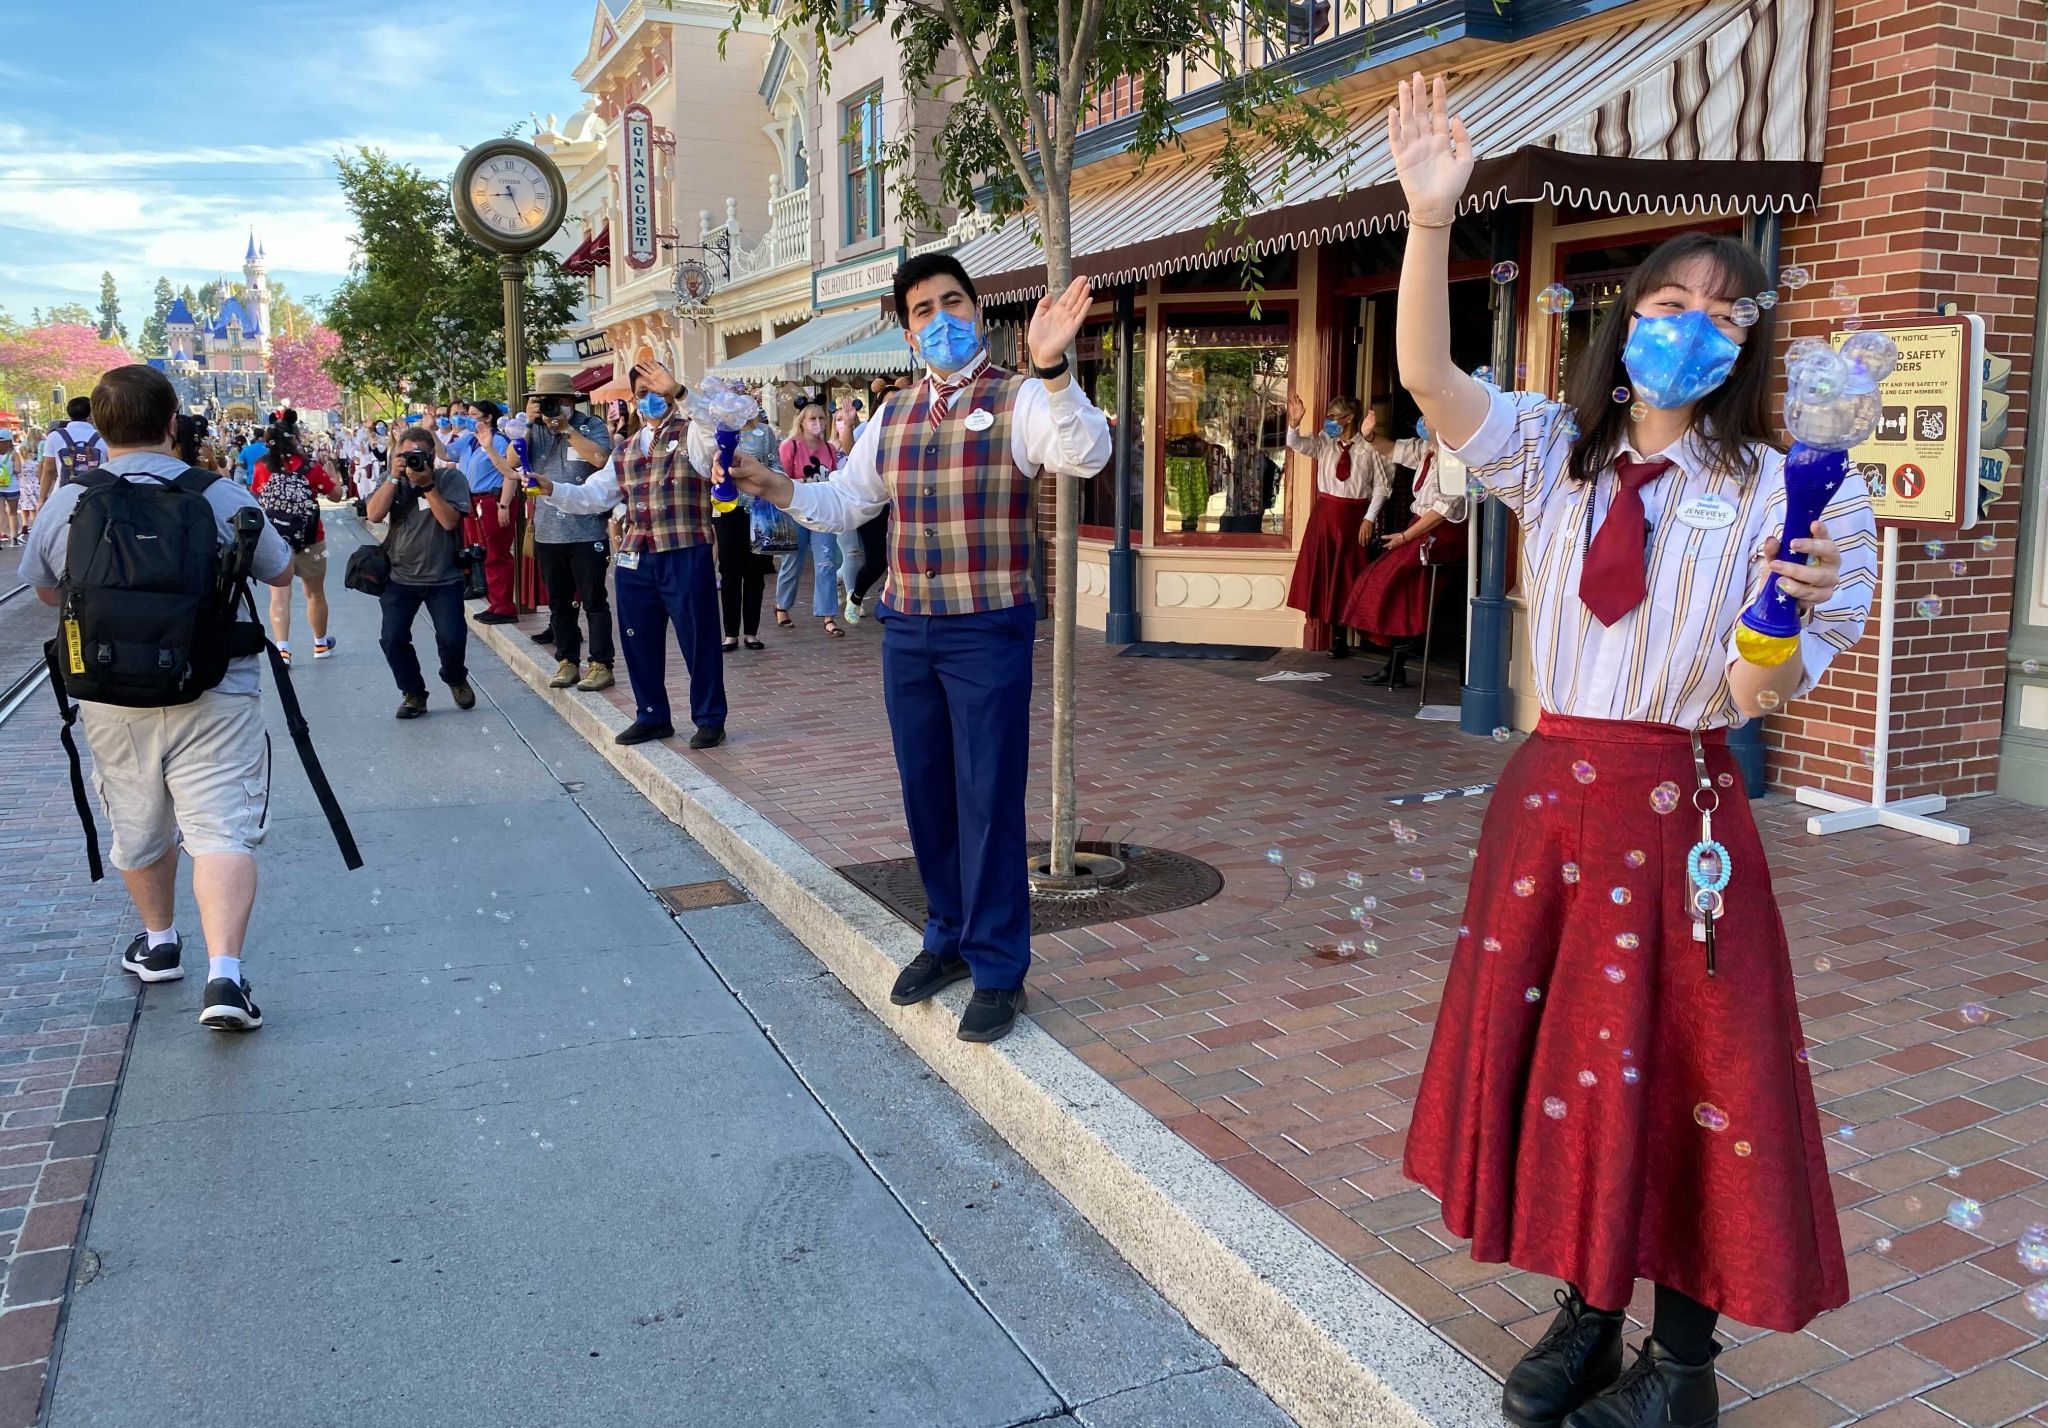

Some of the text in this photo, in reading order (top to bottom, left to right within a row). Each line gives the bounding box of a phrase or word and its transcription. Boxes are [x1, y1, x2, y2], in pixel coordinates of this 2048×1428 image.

[632, 127, 648, 247] CHINA CLOSET
[821, 262, 894, 297] SILHOUETTE STUDIO
[1902, 334, 1929, 342] NOTICE
[1906, 349, 1946, 360] SAFETY
[1684, 508, 1729, 519] JENEVIEVE
